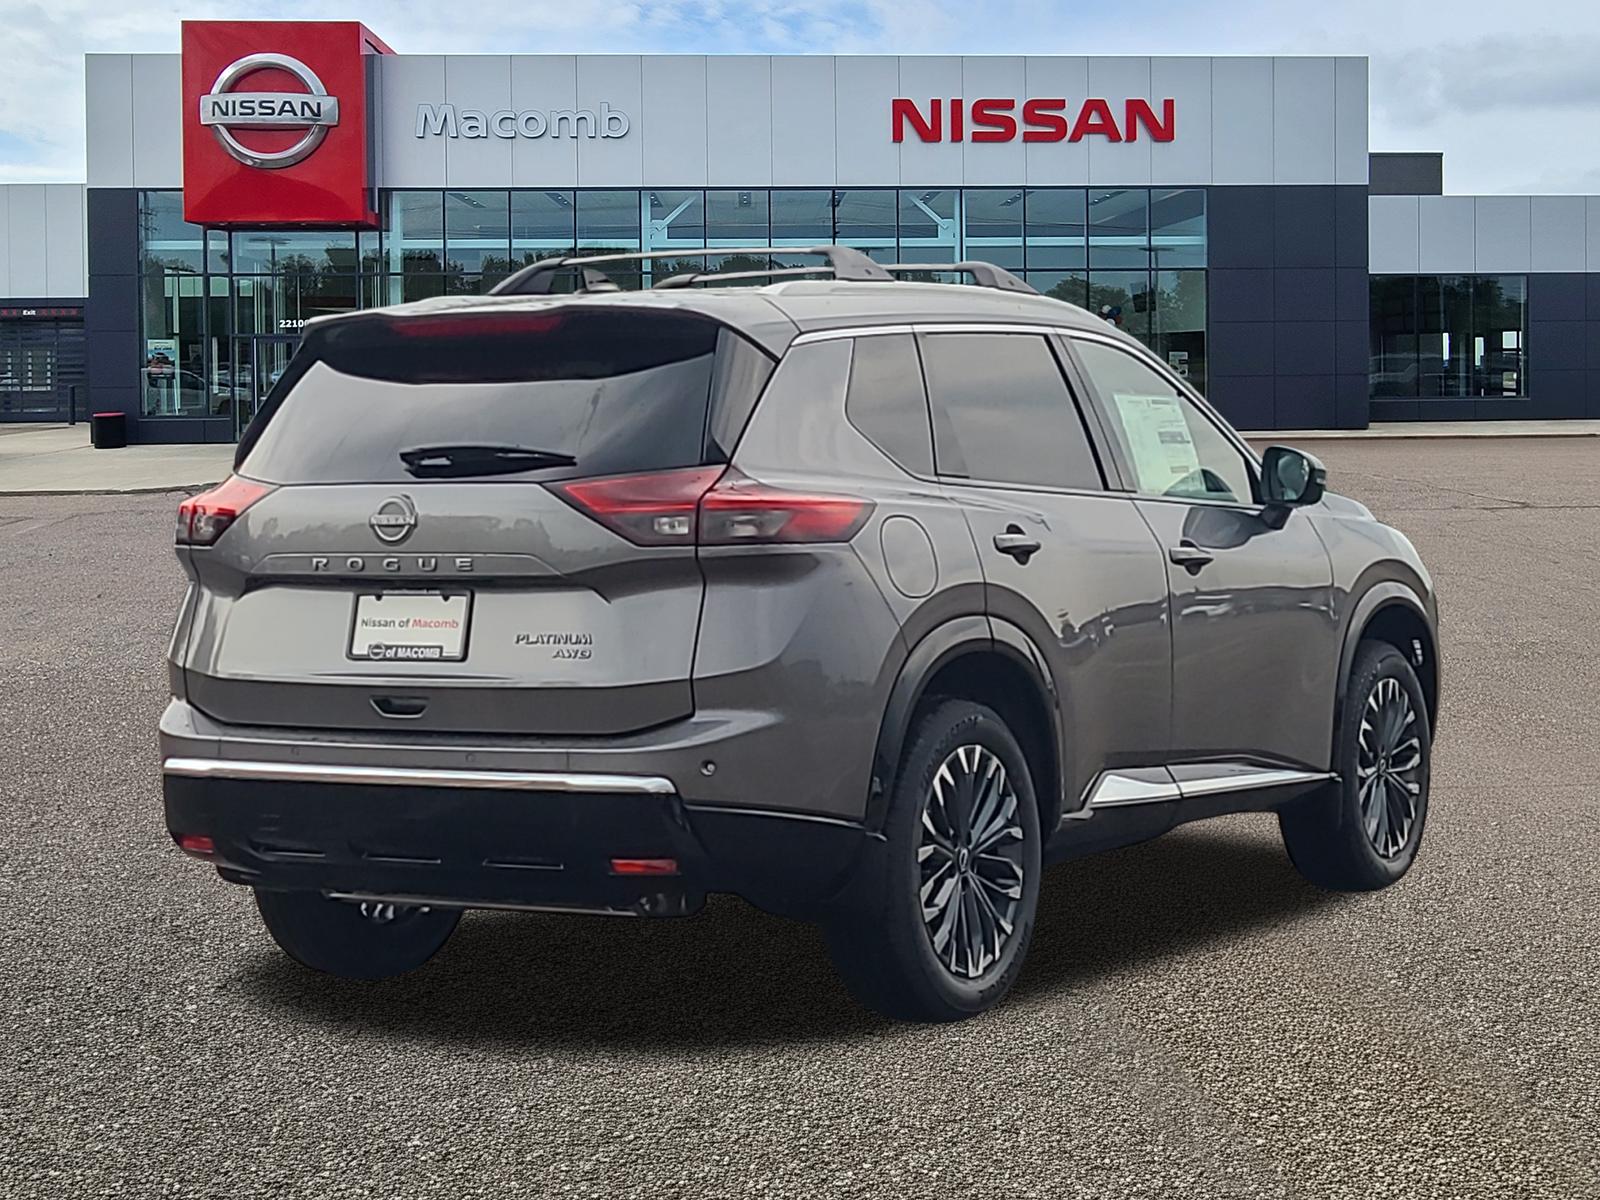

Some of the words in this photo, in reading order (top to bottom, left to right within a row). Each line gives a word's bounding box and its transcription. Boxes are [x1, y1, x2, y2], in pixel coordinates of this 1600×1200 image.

[211, 100, 321, 117] NISSAN
[415, 101, 630, 139] Macomb
[893, 98, 1175, 143] NISSAN
[311, 557, 474, 572] ROGUE
[361, 618, 396, 628] Nissan
[398, 618, 411, 628] of
[411, 618, 459, 629] Macomb
[515, 633, 593, 645] PLATINUM
[385, 647, 396, 658] of
[397, 647, 441, 658] MACOMB
[552, 649, 592, 660] AWD
